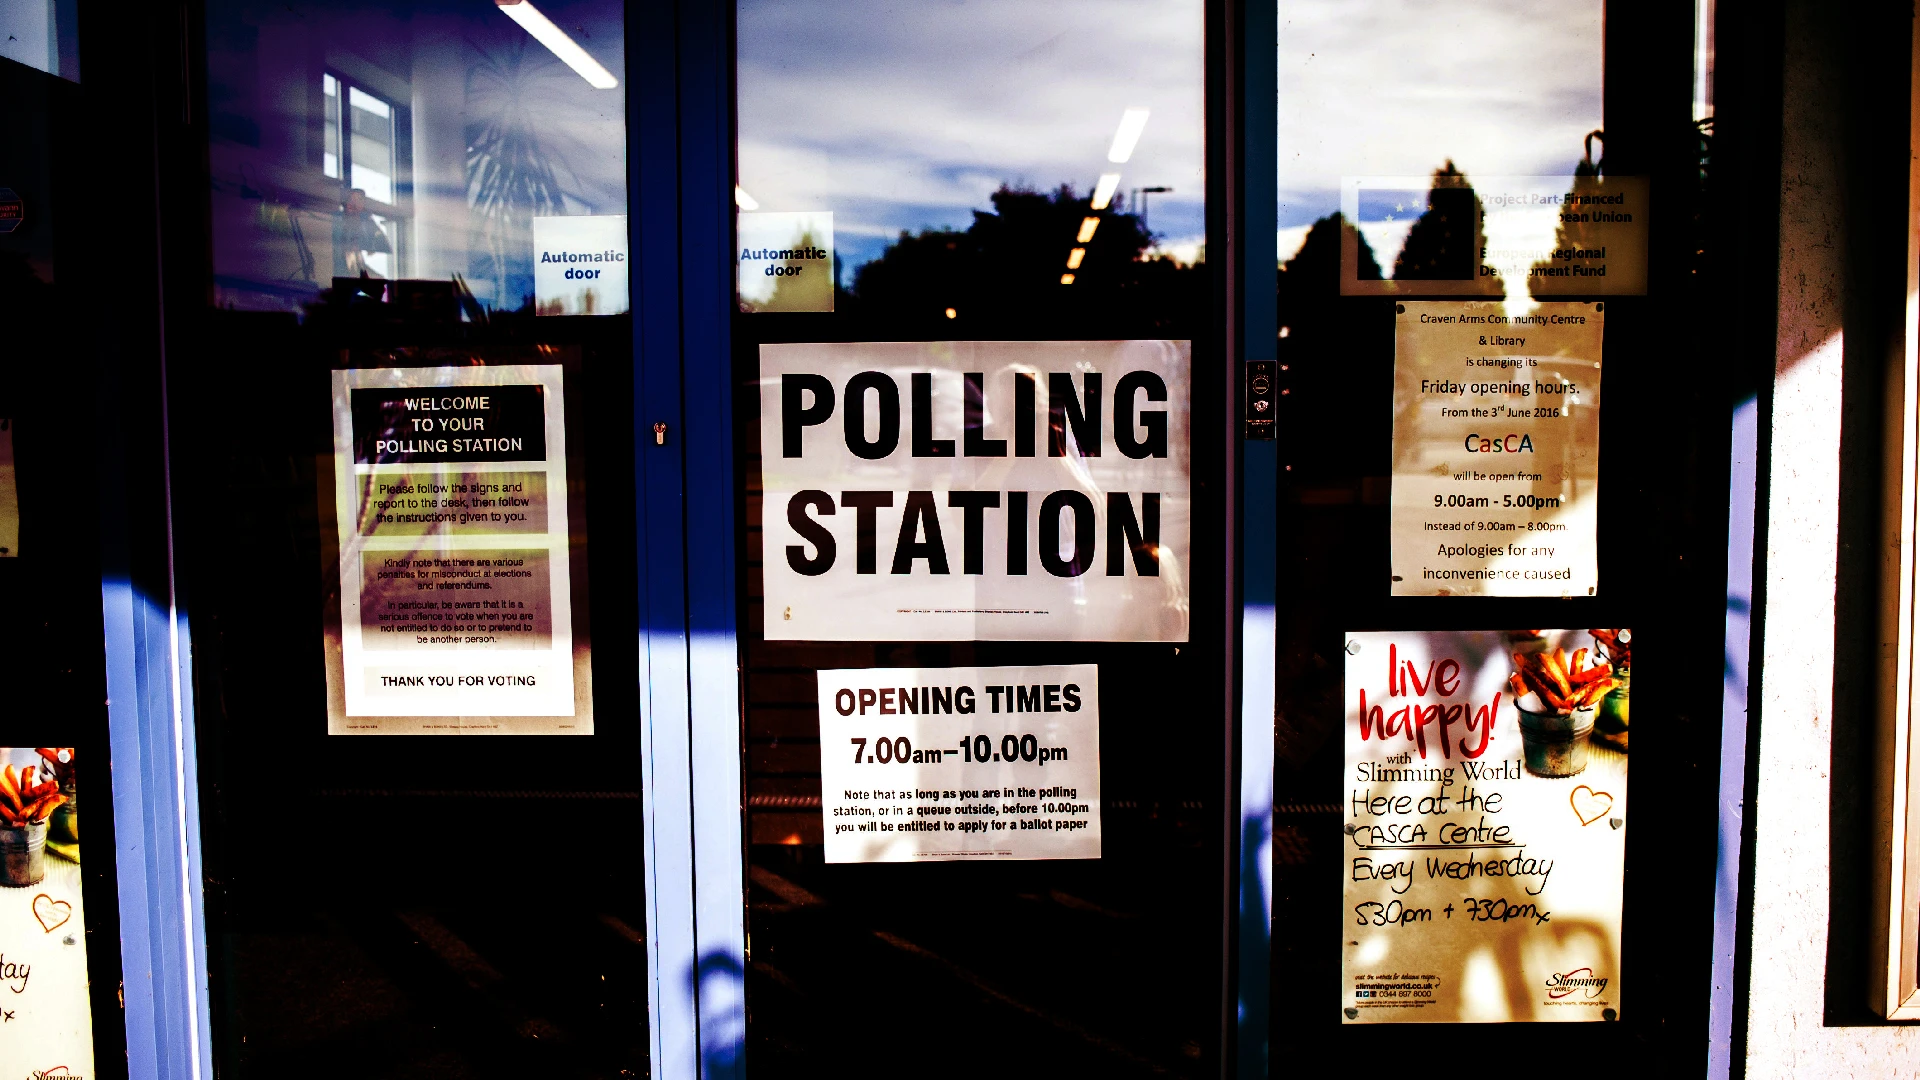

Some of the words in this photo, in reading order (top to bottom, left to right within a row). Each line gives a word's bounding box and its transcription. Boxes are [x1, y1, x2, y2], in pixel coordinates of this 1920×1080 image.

[1480, 193, 1528, 207] Project
[1531, 192, 1624, 205] Part-Financed
[1592, 211, 1633, 223] Union
[541, 251, 625, 264] Automatic
[740, 247, 827, 261] Automatic
[564, 267, 601, 280] door
[765, 264, 803, 277] door
[1573, 264, 1606, 277] Fund
[1420, 313, 1456, 324] Craven
[1458, 313, 1486, 324] Arms
[1487, 313, 1549, 327] Community
[1550, 313, 1586, 325] Centre
[1478, 335, 1488, 346] &
[1490, 335, 1526, 348] Library
[1466, 357, 1474, 367] is
[1476, 356, 1523, 369] changing
[1525, 357, 1538, 367] its
[1421, 379, 1467, 397] Friday
[1470, 379, 1531, 397] opening
[1535, 379, 1580, 394] hours.
[405, 396, 490, 411] WELCOME
[781, 370, 1169, 460] POLLING
[1441, 407, 1469, 418] From
[1470, 406, 1489, 418] the
[1507, 407, 1532, 418] June
[1533, 407, 1560, 418] 2016
[412, 419, 434, 432] TO
[438, 417, 485, 432] YOUR
[376, 439, 448, 454] POLLING
[452, 437, 523, 452] STATION
[1464, 433, 1534, 453] CasCA
[1453, 471, 1471, 481] will
[1473, 471, 1487, 481] be
[1489, 473, 1515, 483] open
[1517, 471, 1542, 481] from
[379, 484, 414, 494] Please
[417, 483, 449, 494] follow
[451, 483, 467, 493] the
[470, 483, 499, 495] signs
[502, 482, 523, 493] and
[373, 498, 405, 509] report
[408, 498, 418, 508] to
[421, 498, 437, 508] the
[441, 497, 469, 509] desk,
[472, 497, 496, 507] then
[499, 496, 530, 507] follow
[1434, 494, 1489, 508] 9.00am
[1502, 494, 1560, 510] 5.00pm
[376, 513, 394, 523] the
[396, 512, 457, 523] instructions
[459, 512, 488, 524] given
[491, 511, 501, 522] to
[504, 512, 528, 524] you.
[1424, 521, 1461, 531] Instead
[1463, 521, 1476, 531] of
[1477, 521, 1515, 531] 9.00am
[785, 489, 1161, 578] STATION
[1437, 543, 1504, 559] Apologies
[1508, 543, 1527, 556] for
[1531, 546, 1555, 558] any
[384, 558, 411, 569] Kindly
[412, 558, 433, 568] note
[434, 558, 451, 567] that
[452, 558, 475, 567] there
[476, 559, 491, 567] are
[493, 558, 524, 567] various
[377, 570, 416, 581] penalties
[417, 570, 430, 579] for
[431, 569, 482, 578] misconduct
[484, 570, 492, 578] at
[493, 569, 532, 578] elections
[1423, 567, 1520, 580] inconvenience
[1523, 567, 1571, 580] caused
[417, 581, 434, 590] and
[436, 581, 492, 590] referendums.
[380, 624, 394, 633] not
[397, 623, 428, 633] entitled
[429, 623, 439, 632] to
[440, 623, 452, 632] do
[454, 624, 465, 632] so
[466, 624, 476, 632] or
[478, 623, 487, 631] to
[489, 623, 521, 633] pretend
[523, 623, 533, 631] to
[417, 635, 428, 644] be
[430, 635, 462, 644] another
[1389, 643, 1461, 697] live
[380, 676, 425, 687] THANK
[428, 675, 455, 687] YOU
[458, 675, 484, 687] FOR
[487, 675, 536, 687] VOTING
[835, 686, 976, 717] OPENING
[985, 683, 1082, 714] TIMES
[1359, 688, 1502, 760] happy!
[1386, 752, 1412, 764] with
[1356, 761, 1455, 786] Slimming
[1460, 759, 1522, 781] World
[844, 790, 870, 800] Note
[873, 789, 896, 800] that
[899, 791, 912, 800] as
[915, 789, 940, 801] long
[942, 790, 957, 799] as
[959, 789, 979, 801] you
[982, 789, 1000, 799] are
[1003, 787, 1015, 798] in
[1017, 787, 1036, 798] the
[1039, 787, 1077, 800] polling
[1352, 788, 1412, 817] Here
[1417, 785, 1450, 816] at
[1456, 785, 1503, 814] the
[833, 805, 875, 818] station,
[878, 807, 890, 816] or
[893, 805, 903, 816] in
[906, 807, 914, 815] a
[916, 805, 951, 817] queue
[954, 803, 1000, 817] outside,
[1003, 803, 1038, 814] before
[1041, 802, 1089, 816] 10.00pm
[835, 823, 855, 834] you
[858, 821, 877, 832] will
[880, 820, 894, 831] be
[897, 820, 941, 832] entitled
[944, 820, 956, 831] to
[958, 820, 989, 833] apply
[991, 819, 1007, 831] for
[1009, 821, 1018, 830] a
[1020, 818, 1053, 830] ballot
[1055, 819, 1088, 832] paper
[1352, 824, 1428, 847] CASCA
[1439, 815, 1513, 845] Centre
[1352, 857, 1414, 894] Every
[1427, 849, 1554, 895] Wednesday
[1443, 903, 1454, 919] +
[1355, 982, 1433, 991] slimmingworld.co.uk
[1546, 972, 1609, 998] Slimming
